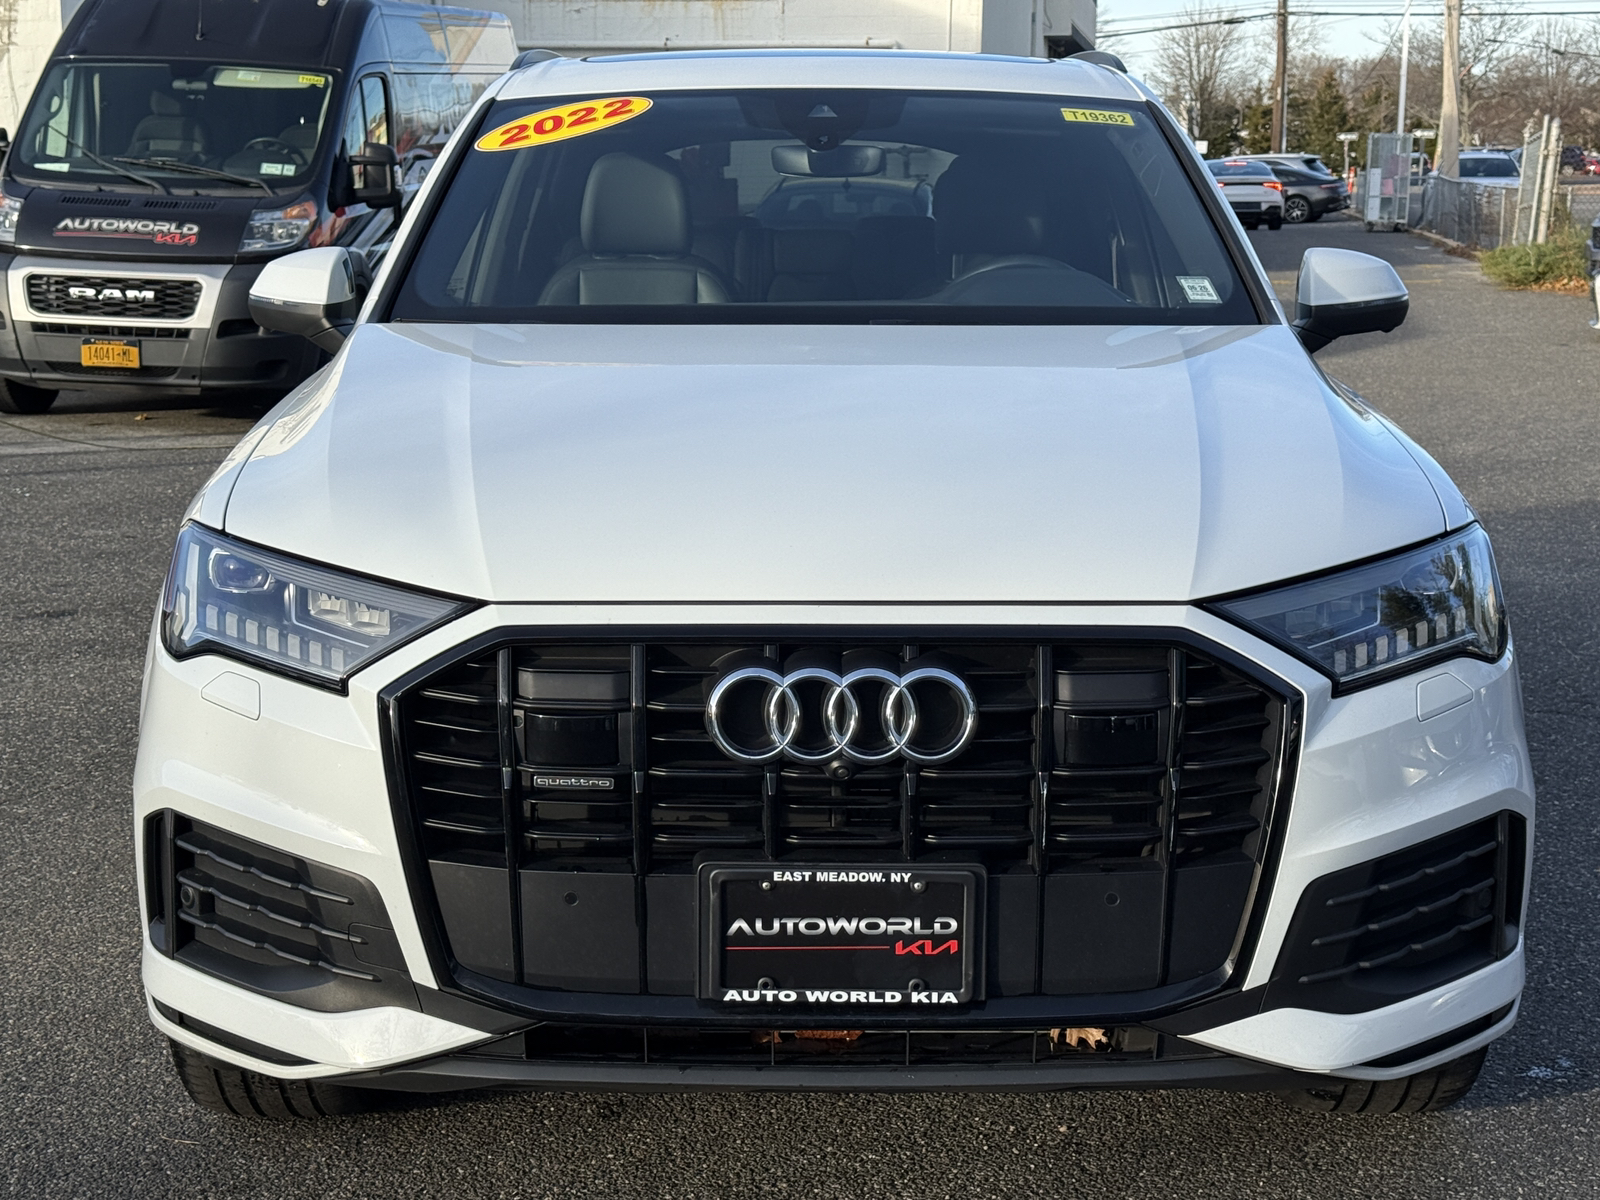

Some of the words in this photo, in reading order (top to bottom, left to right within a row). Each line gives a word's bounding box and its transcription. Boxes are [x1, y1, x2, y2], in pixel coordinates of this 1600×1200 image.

[499, 98, 634, 147] 2022
[1068, 110, 1129, 124] T19362
[57, 217, 199, 233] AUTOWORLD
[155, 233, 197, 244] KIA
[68, 287, 154, 301] RAM
[537, 778, 610, 787] quattro
[773, 871, 812, 882] EAST
[890, 872, 912, 883] NY
[726, 917, 958, 936] AUTOWORLD
[895, 940, 958, 955] KIA
[723, 990, 797, 1002] AUTO
[805, 990, 902, 1003] WORLD
[911, 991, 958, 1004] KIA
